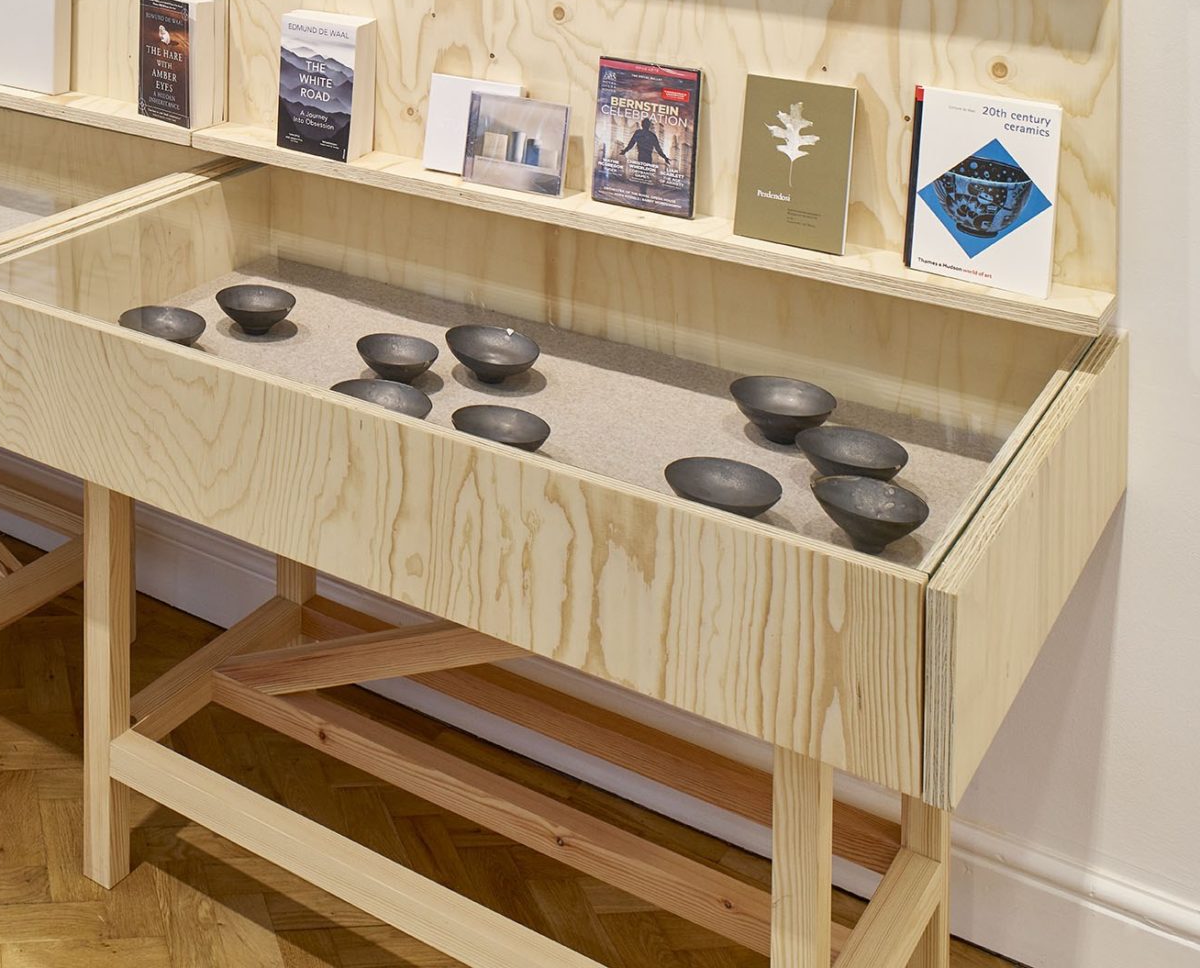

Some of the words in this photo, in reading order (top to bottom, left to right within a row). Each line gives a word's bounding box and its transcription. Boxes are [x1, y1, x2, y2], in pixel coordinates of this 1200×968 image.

[145, 12, 164, 22] EDMUND
[172, 17, 184, 26] WAAL
[288, 22, 317, 34] EDMUND
[319, 28, 328, 36] DE
[330, 30, 349, 40] WAAL
[146, 44, 161, 57] THE
[163, 48, 183, 62] HARE
[157, 59, 173, 70] WITH
[306, 60, 326, 73] THE
[152, 68, 177, 82] AMBER
[299, 72, 333, 89] WHITE
[156, 80, 173, 93] EYES
[301, 88, 331, 103] ROAD
[610, 96, 679, 117] BERNSTEIN
[293, 115, 304, 124] Into
[305, 117, 335, 131] Obsession
[306, 111, 328, 123] Journey
[601, 104, 688, 128] CELEBRATION
[982, 106, 1007, 119] 20th
[1011, 112, 1052, 128] century
[1004, 122, 1050, 138] ceramics
[918, 256, 938, 267] Thames
[943, 263, 962, 271] Hudson
